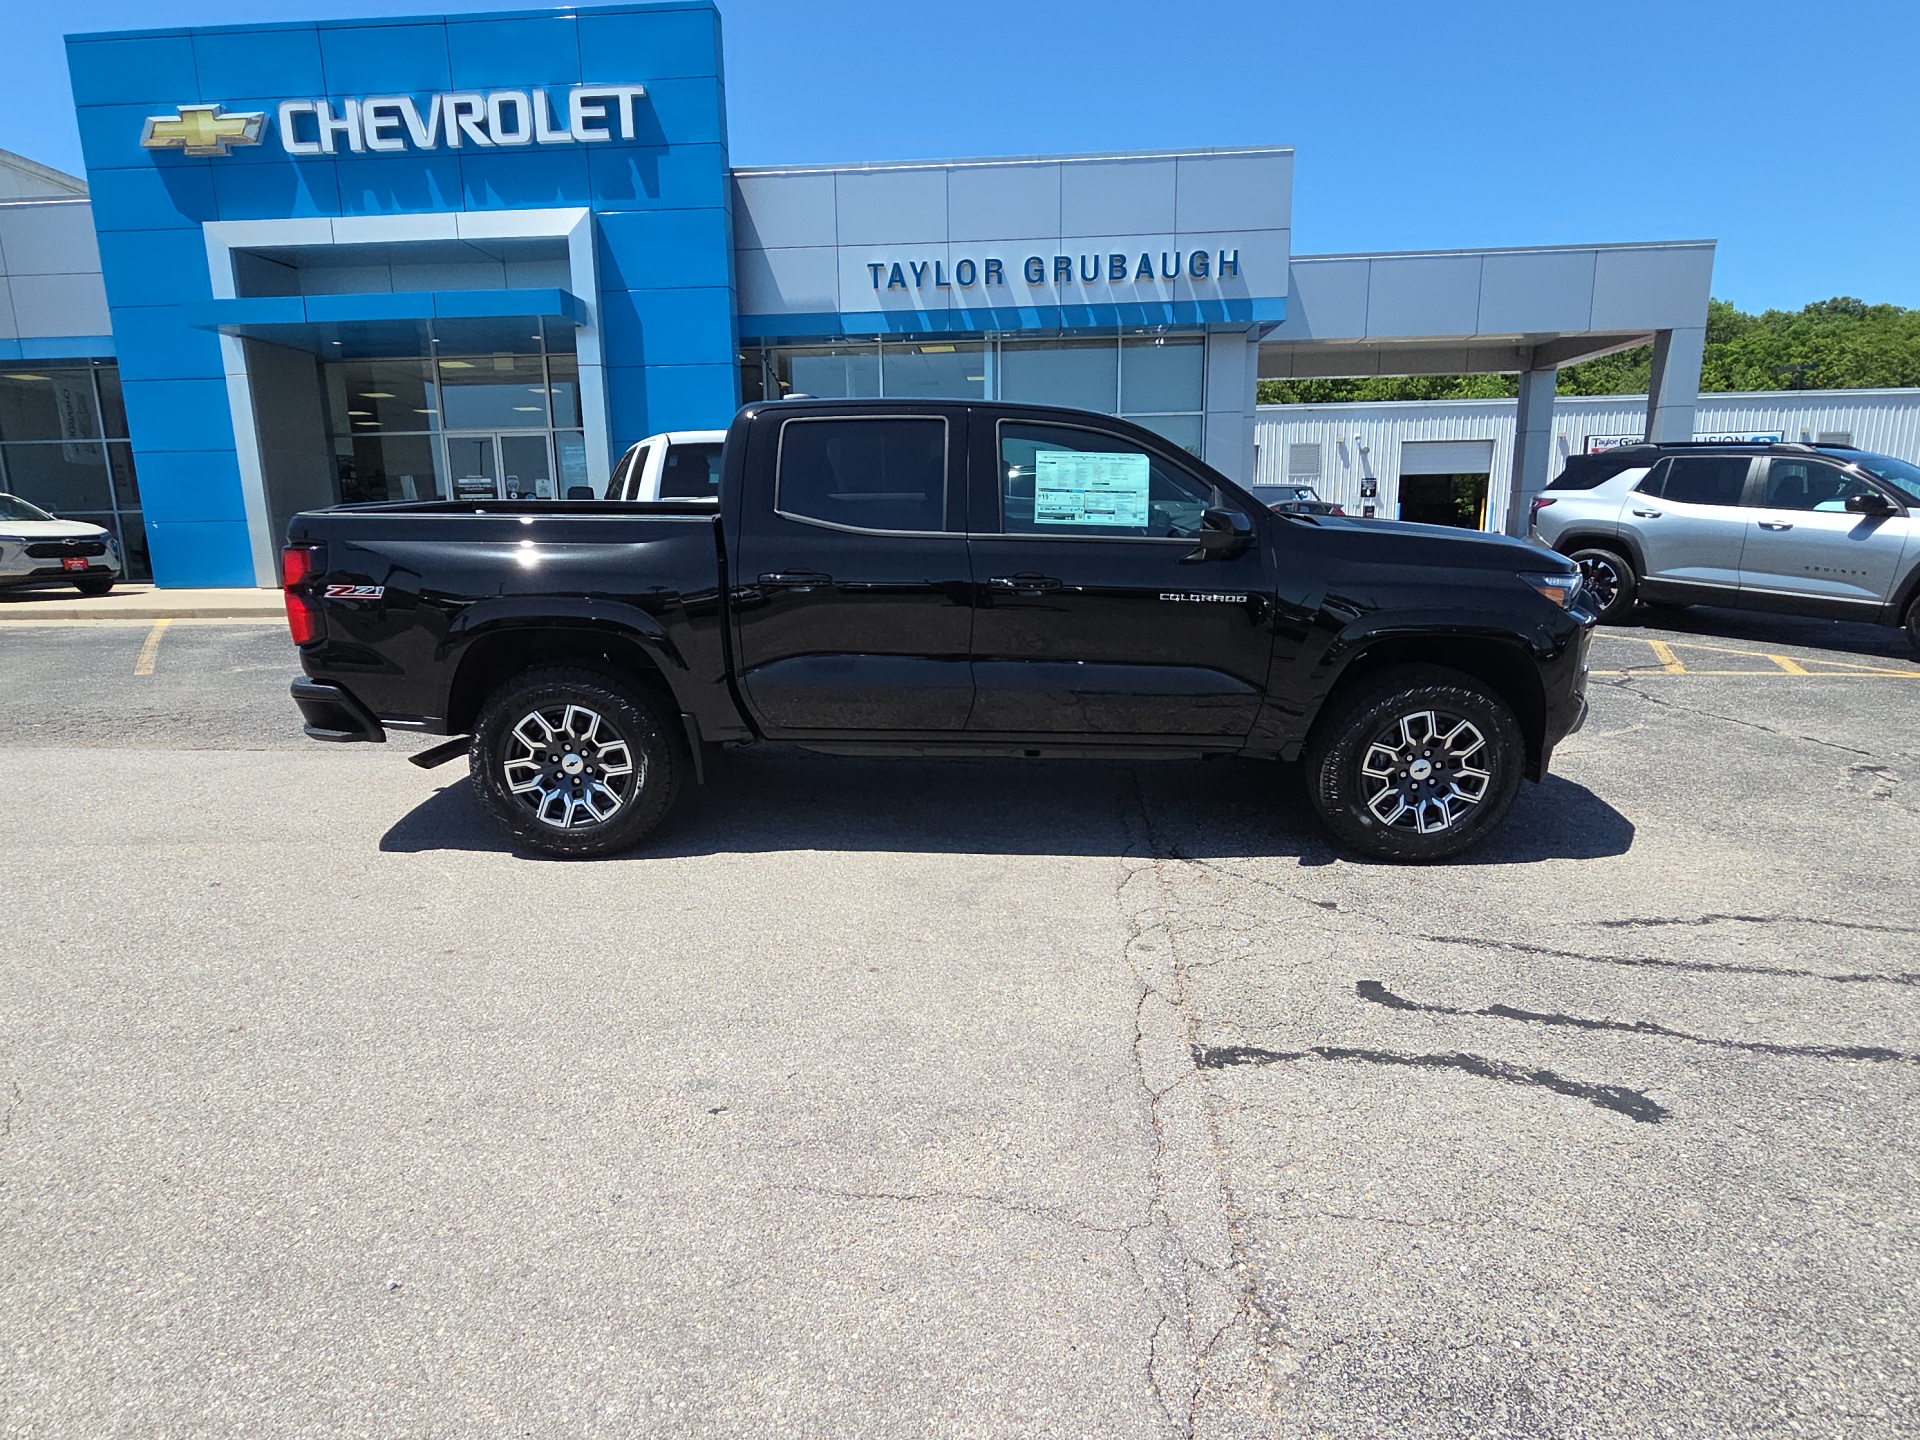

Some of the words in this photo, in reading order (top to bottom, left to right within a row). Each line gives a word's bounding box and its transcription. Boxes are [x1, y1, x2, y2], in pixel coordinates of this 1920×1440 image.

[278, 85, 646, 155] CHEVROLET
[867, 258, 1004, 289] TAYLOR
[1023, 249, 1240, 286] GRUBAUGH
[1591, 437, 1618, 447] Taylor
[324, 584, 385, 599] Z71
[1159, 592, 1248, 603] COLORADO
